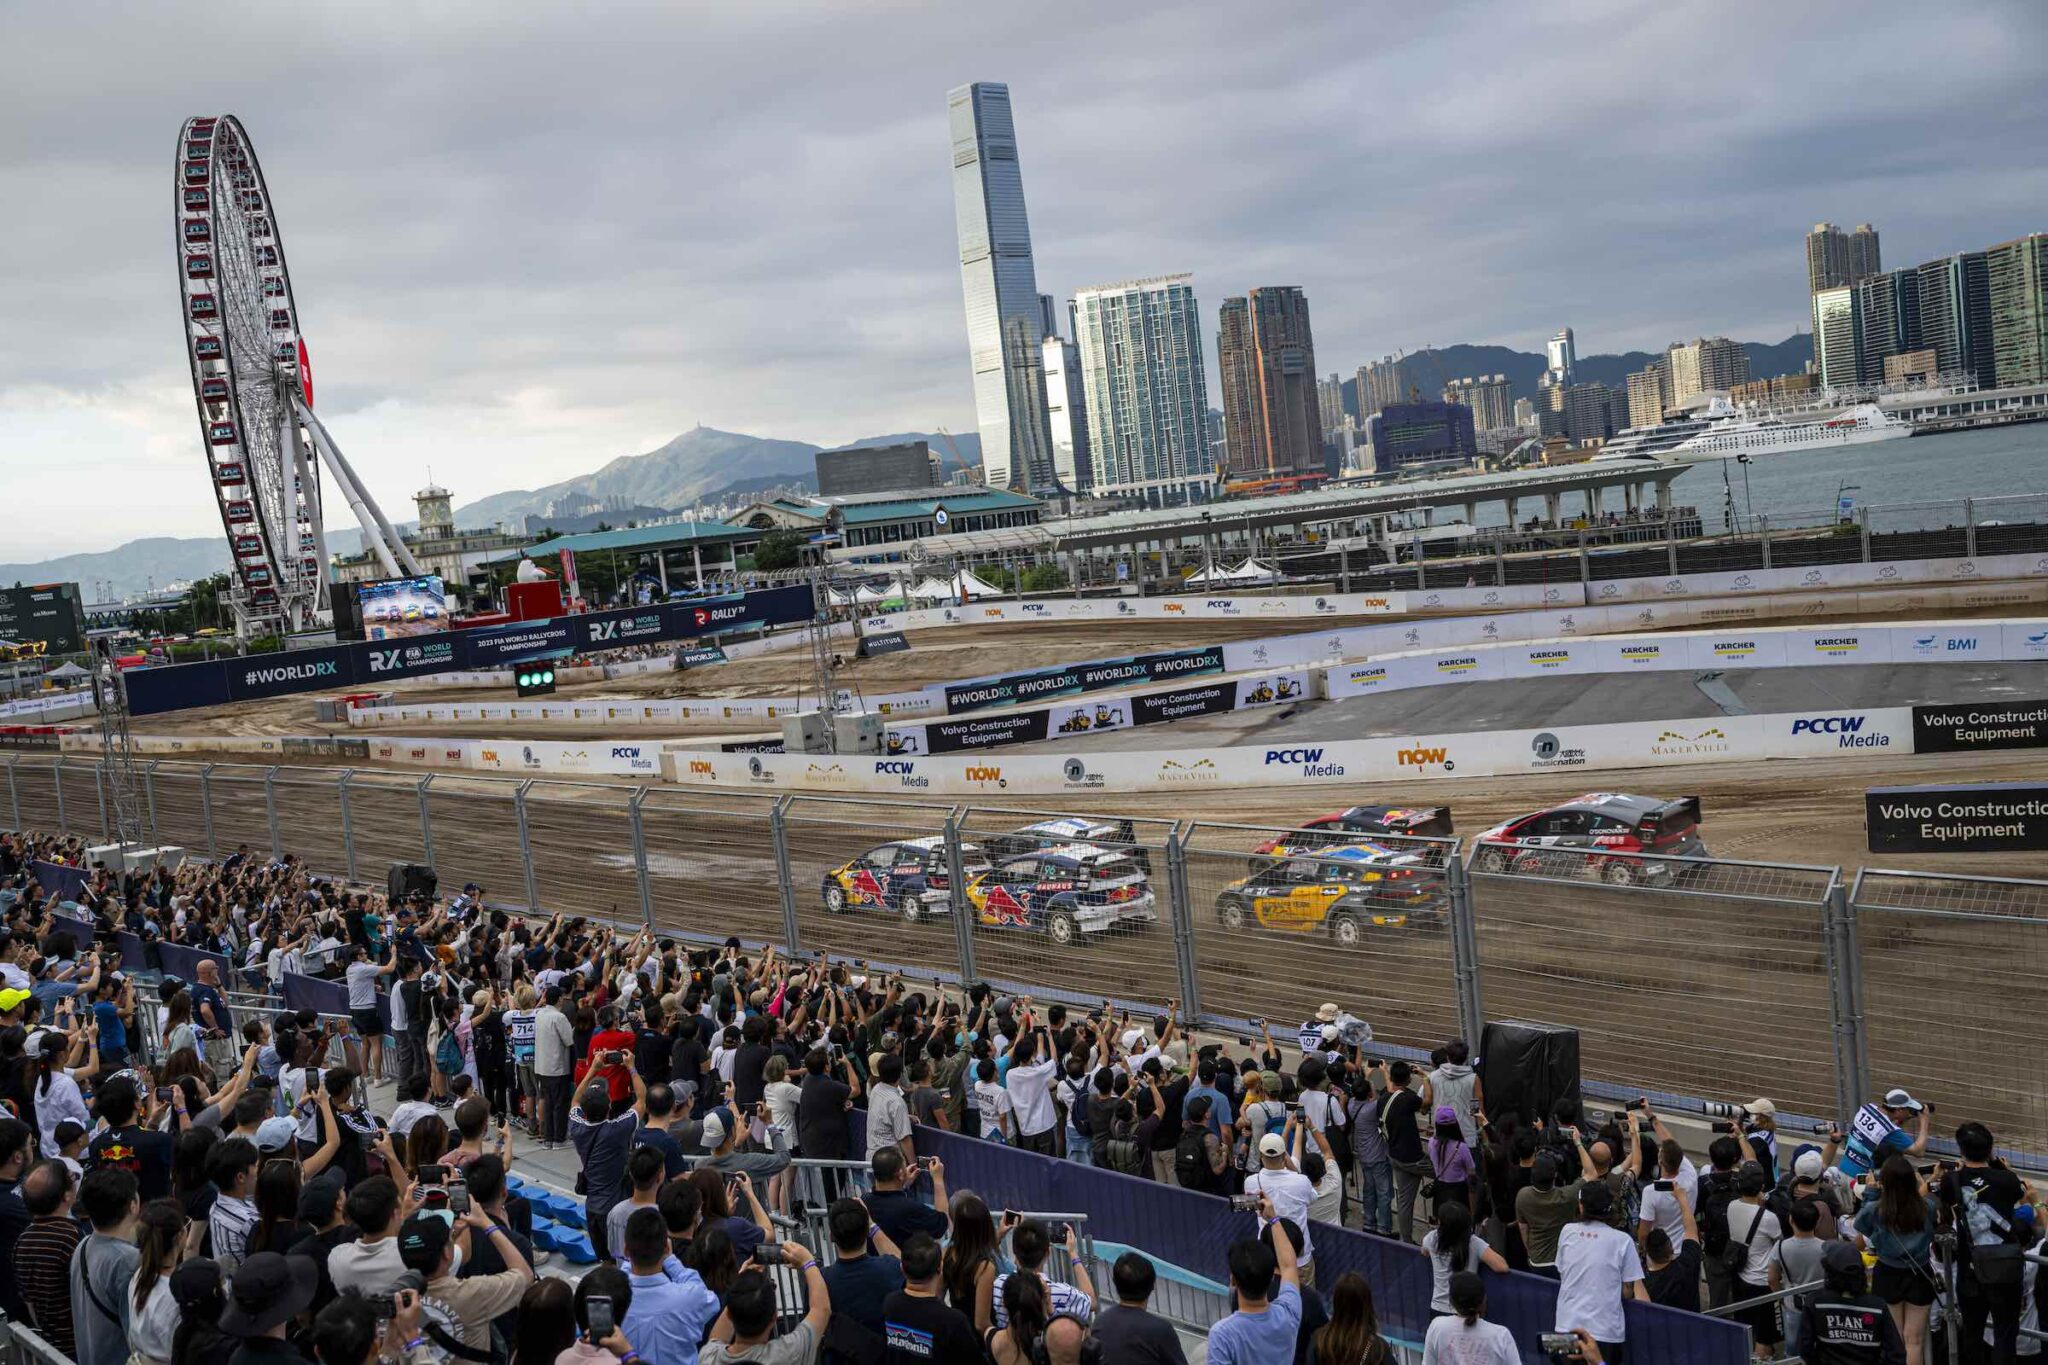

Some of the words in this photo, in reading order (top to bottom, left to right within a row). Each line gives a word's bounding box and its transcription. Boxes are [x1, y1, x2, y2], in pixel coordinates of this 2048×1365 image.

[1022, 604, 1044, 612] PCCW
[1164, 603, 1183, 612] now
[1365, 597, 1387, 607] now
[635, 615, 660, 623] WORLD
[711, 608, 738, 620] RALLY
[737, 606, 746, 614] TV
[868, 618, 886, 627] PCCW
[590, 621, 618, 642] RX
[621, 627, 662, 638] CHAMPIONSHIP
[478, 639, 493, 648] 2023
[494, 637, 505, 645] FIA
[505, 634, 528, 644] WORLD
[529, 629, 566, 641] RALLYCROSS
[867, 637, 901, 648] MULTITUDE
[1947, 638, 1977, 650] BMI
[423, 643, 452, 651] WORLD
[500, 640, 547, 652] CHAMPIONSHIP
[406, 649, 421, 658] FIA
[685, 652, 721, 663] #WORLDRX
[370, 649, 402, 672] RX
[406, 655, 453, 667] CHAMPIONSHIP
[1154, 655, 1219, 673] #WORLDRX
[246, 661, 337, 685] #WORLDRX
[1086, 665, 1148, 683] #WORLDRX
[1018, 674, 1079, 695] #WORLDRX
[951, 686, 1013, 705] #WORLDRX
[1145, 697, 1167, 708] Volvo
[1169, 689, 1220, 704] Construction
[1162, 701, 1206, 717] Equipment
[1923, 714, 1964, 727] Volvo
[1968, 709, 2048, 724] Constructi
[941, 726, 968, 736] Volvo
[970, 717, 1031, 732] Construction
[1791, 716, 1865, 735] PCCW
[962, 730, 1014, 745] Equipment
[1955, 725, 2036, 742] Equipment
[1839, 733, 1889, 748] Media
[482, 749, 497, 761] now
[612, 748, 640, 758] PCCW
[1265, 748, 1323, 765] PCCW
[1398, 748, 1447, 766] now
[631, 759, 652, 769] Media
[690, 761, 712, 774] now
[876, 762, 914, 774] PCCW
[1531, 757, 1585, 768] musicnation
[966, 767, 1000, 781] now
[1304, 763, 1344, 777] Media
[902, 776, 929, 788] Media
[1880, 803, 1932, 819] Volvo
[1594, 817, 1602, 827] 7
[1921, 822, 2025, 841] Equipment
[1044, 865, 1056, 875] 96
[1037, 882, 1073, 891] BAUHAUS
[517, 1025, 533, 1034] 714
[1303, 1038, 1316, 1047] 107
[1859, 1113, 1877, 1131] 136
[1826, 1315, 1863, 1329] PLAN
[1828, 1330, 1873, 1342] SECURITY
